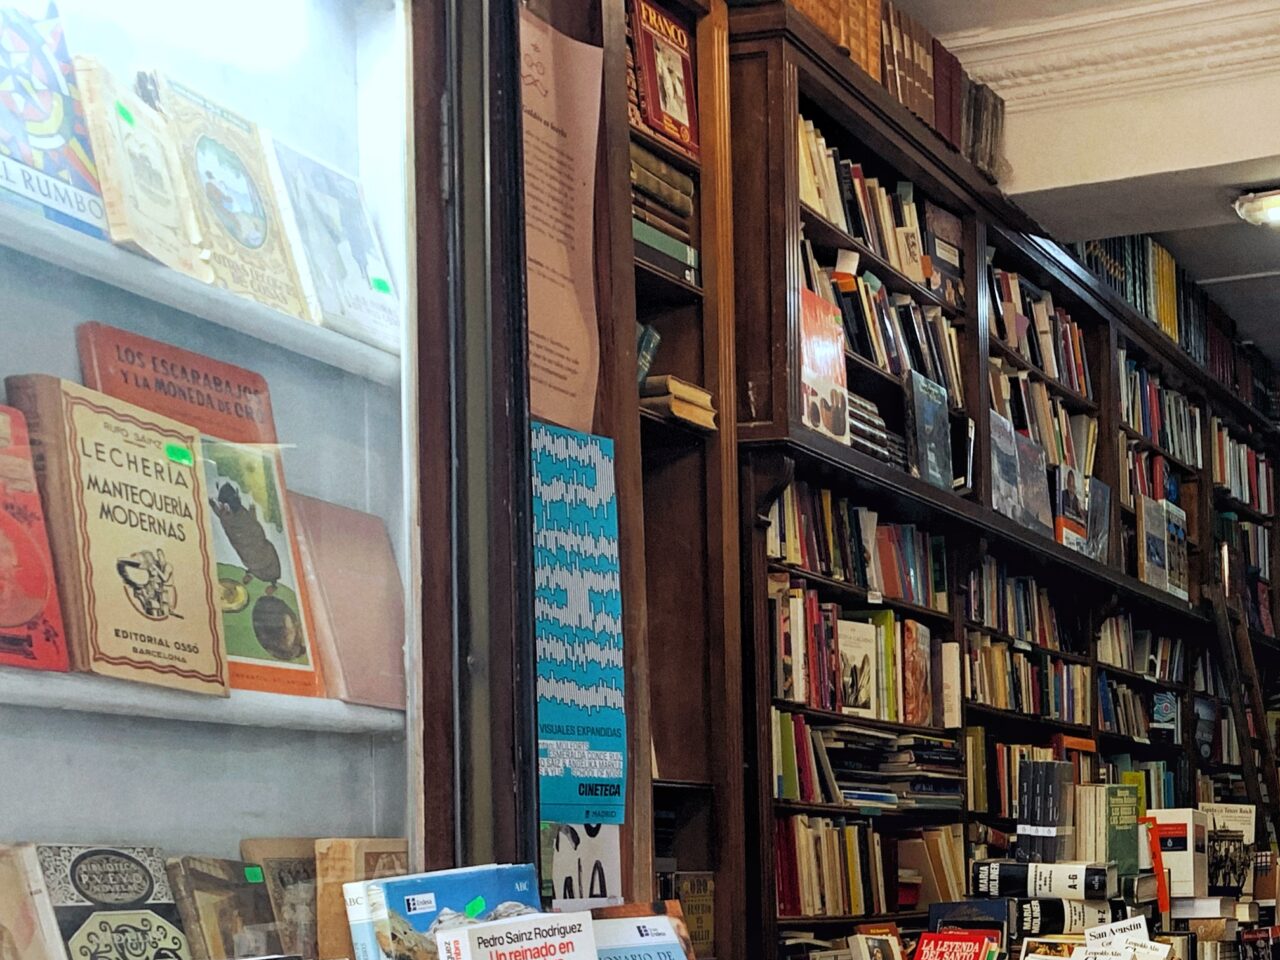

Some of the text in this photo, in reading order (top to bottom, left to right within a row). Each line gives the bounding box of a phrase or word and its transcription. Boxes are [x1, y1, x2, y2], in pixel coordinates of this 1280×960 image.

[641, 2, 688, 49] FRANCO
[20, 168, 104, 219] RUMBO
[116, 345, 262, 404] LOS ESCARABAJOS
[120, 369, 129, 384] Y
[134, 374, 150, 391] LA
[155, 377, 214, 409] MONEDA
[217, 400, 232, 417] DE
[81, 437, 189, 489] LECHERÍA
[87, 473, 193, 520] MANTEQUERÍA
[99, 502, 187, 542] MODERNAS
[114, 628, 171, 649] EDITORIAL
[132, 645, 188, 664] BARCELONA
[539, 724, 622, 738] VISUALES EXPANDIDAS
[578, 783, 620, 796] CINETECA
[515, 881, 529, 892] ABC
[989, 863, 1000, 896] MOLINER
[1068, 874, 1078, 890] A-G
[1031, 900, 1040, 934] MOLINER
[1098, 909, 1106, 923] H-Z
[477, 930, 533, 949] Pedro Sainz
[1089, 930, 1107, 941] San
[558, 940, 575, 954] en
[921, 951, 940, 960] DEL
[922, 940, 980, 953] LA LEYENDA
